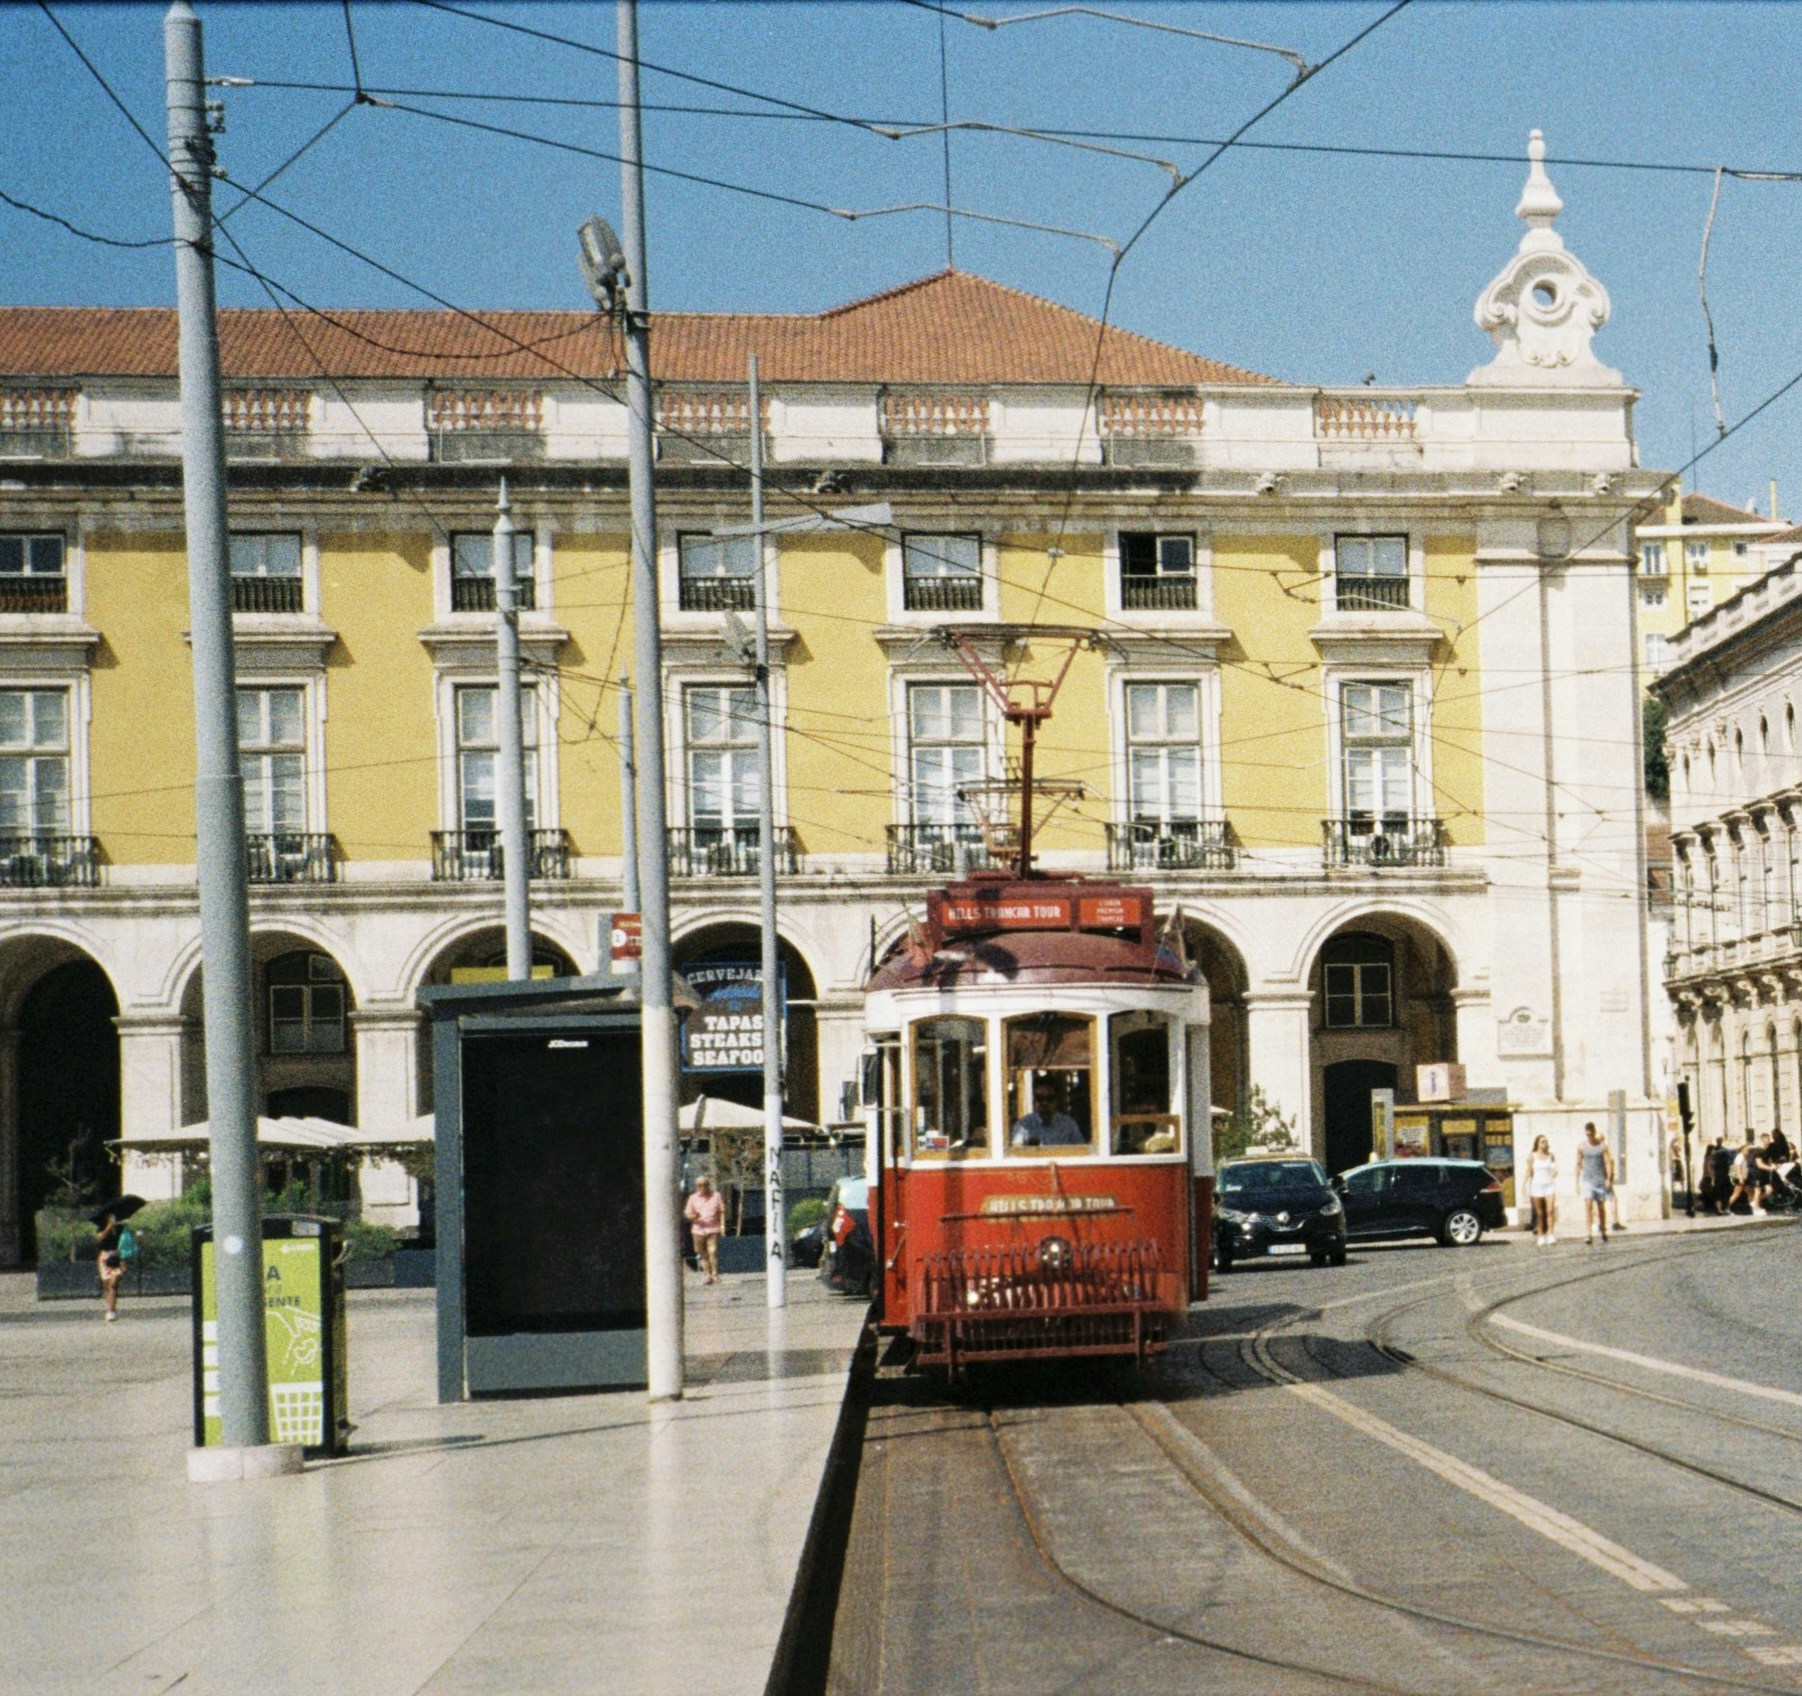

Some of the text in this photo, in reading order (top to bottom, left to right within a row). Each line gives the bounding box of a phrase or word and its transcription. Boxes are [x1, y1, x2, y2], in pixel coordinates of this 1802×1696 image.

[948, 906, 980, 920] HILLS
[1033, 905, 1061, 918] TOUR
[687, 968, 764, 985] CERVEJAR
[704, 1015, 764, 1030] TAPAS
[690, 1032, 763, 1048] STEAKS
[693, 1049, 764, 1065] SEAFOO
